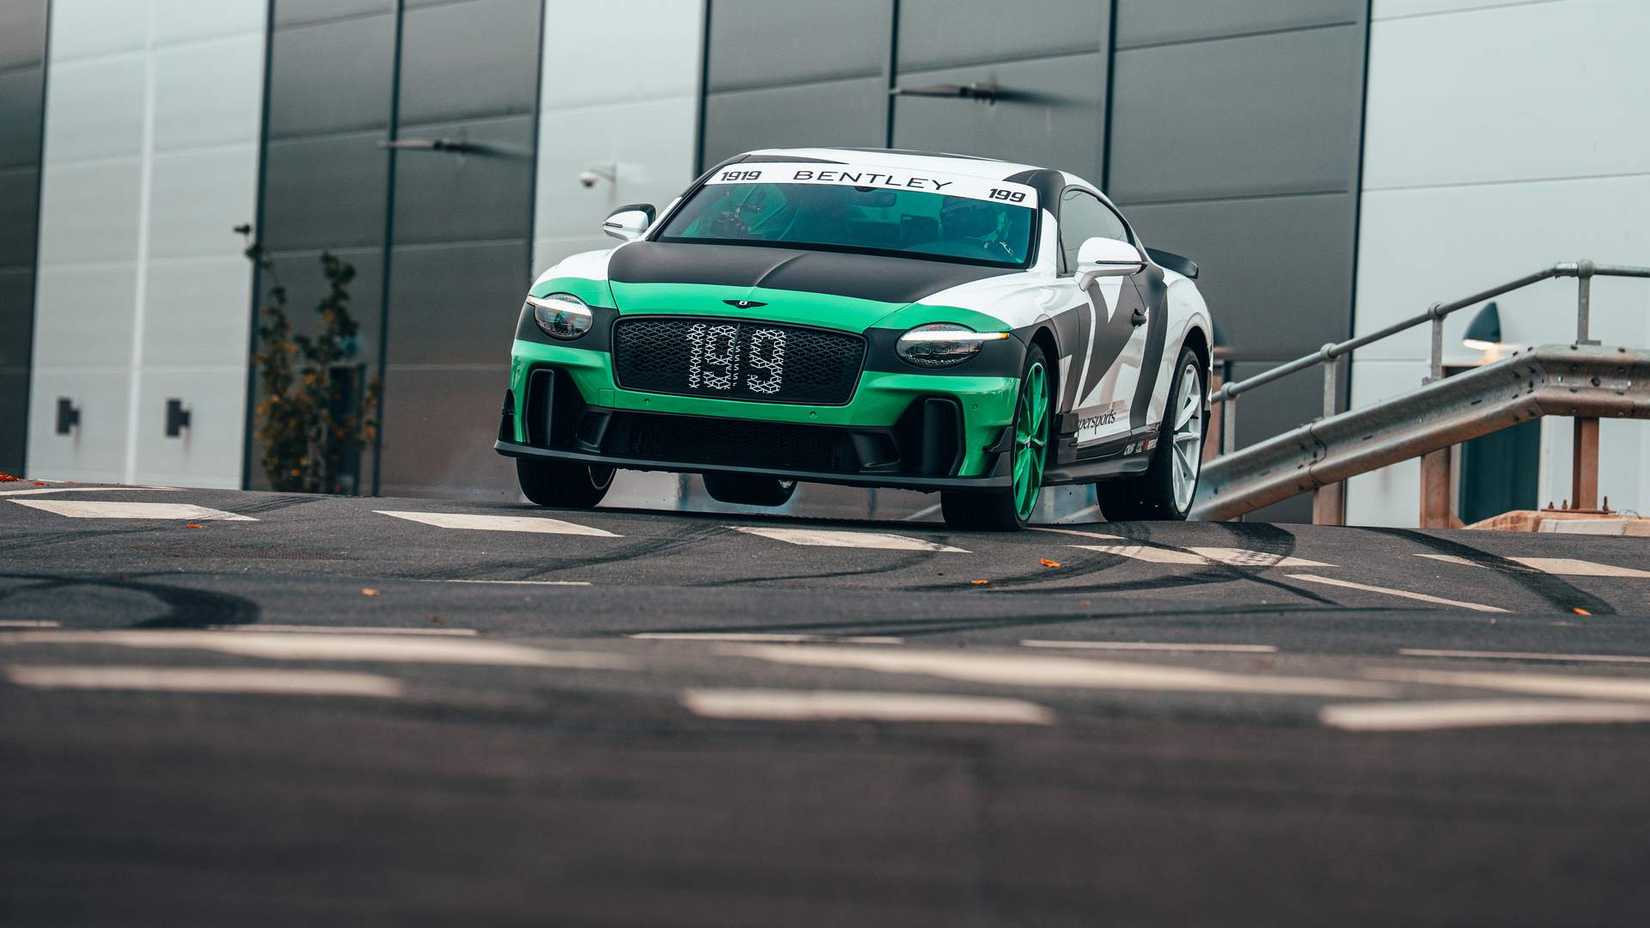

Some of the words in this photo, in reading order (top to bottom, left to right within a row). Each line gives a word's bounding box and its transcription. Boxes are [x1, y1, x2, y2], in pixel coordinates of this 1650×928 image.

[720, 170, 763, 182] 1919
[793, 170, 953, 191] BENTLEY
[988, 188, 1026, 203] 199
[686, 323, 787, 394] 199
